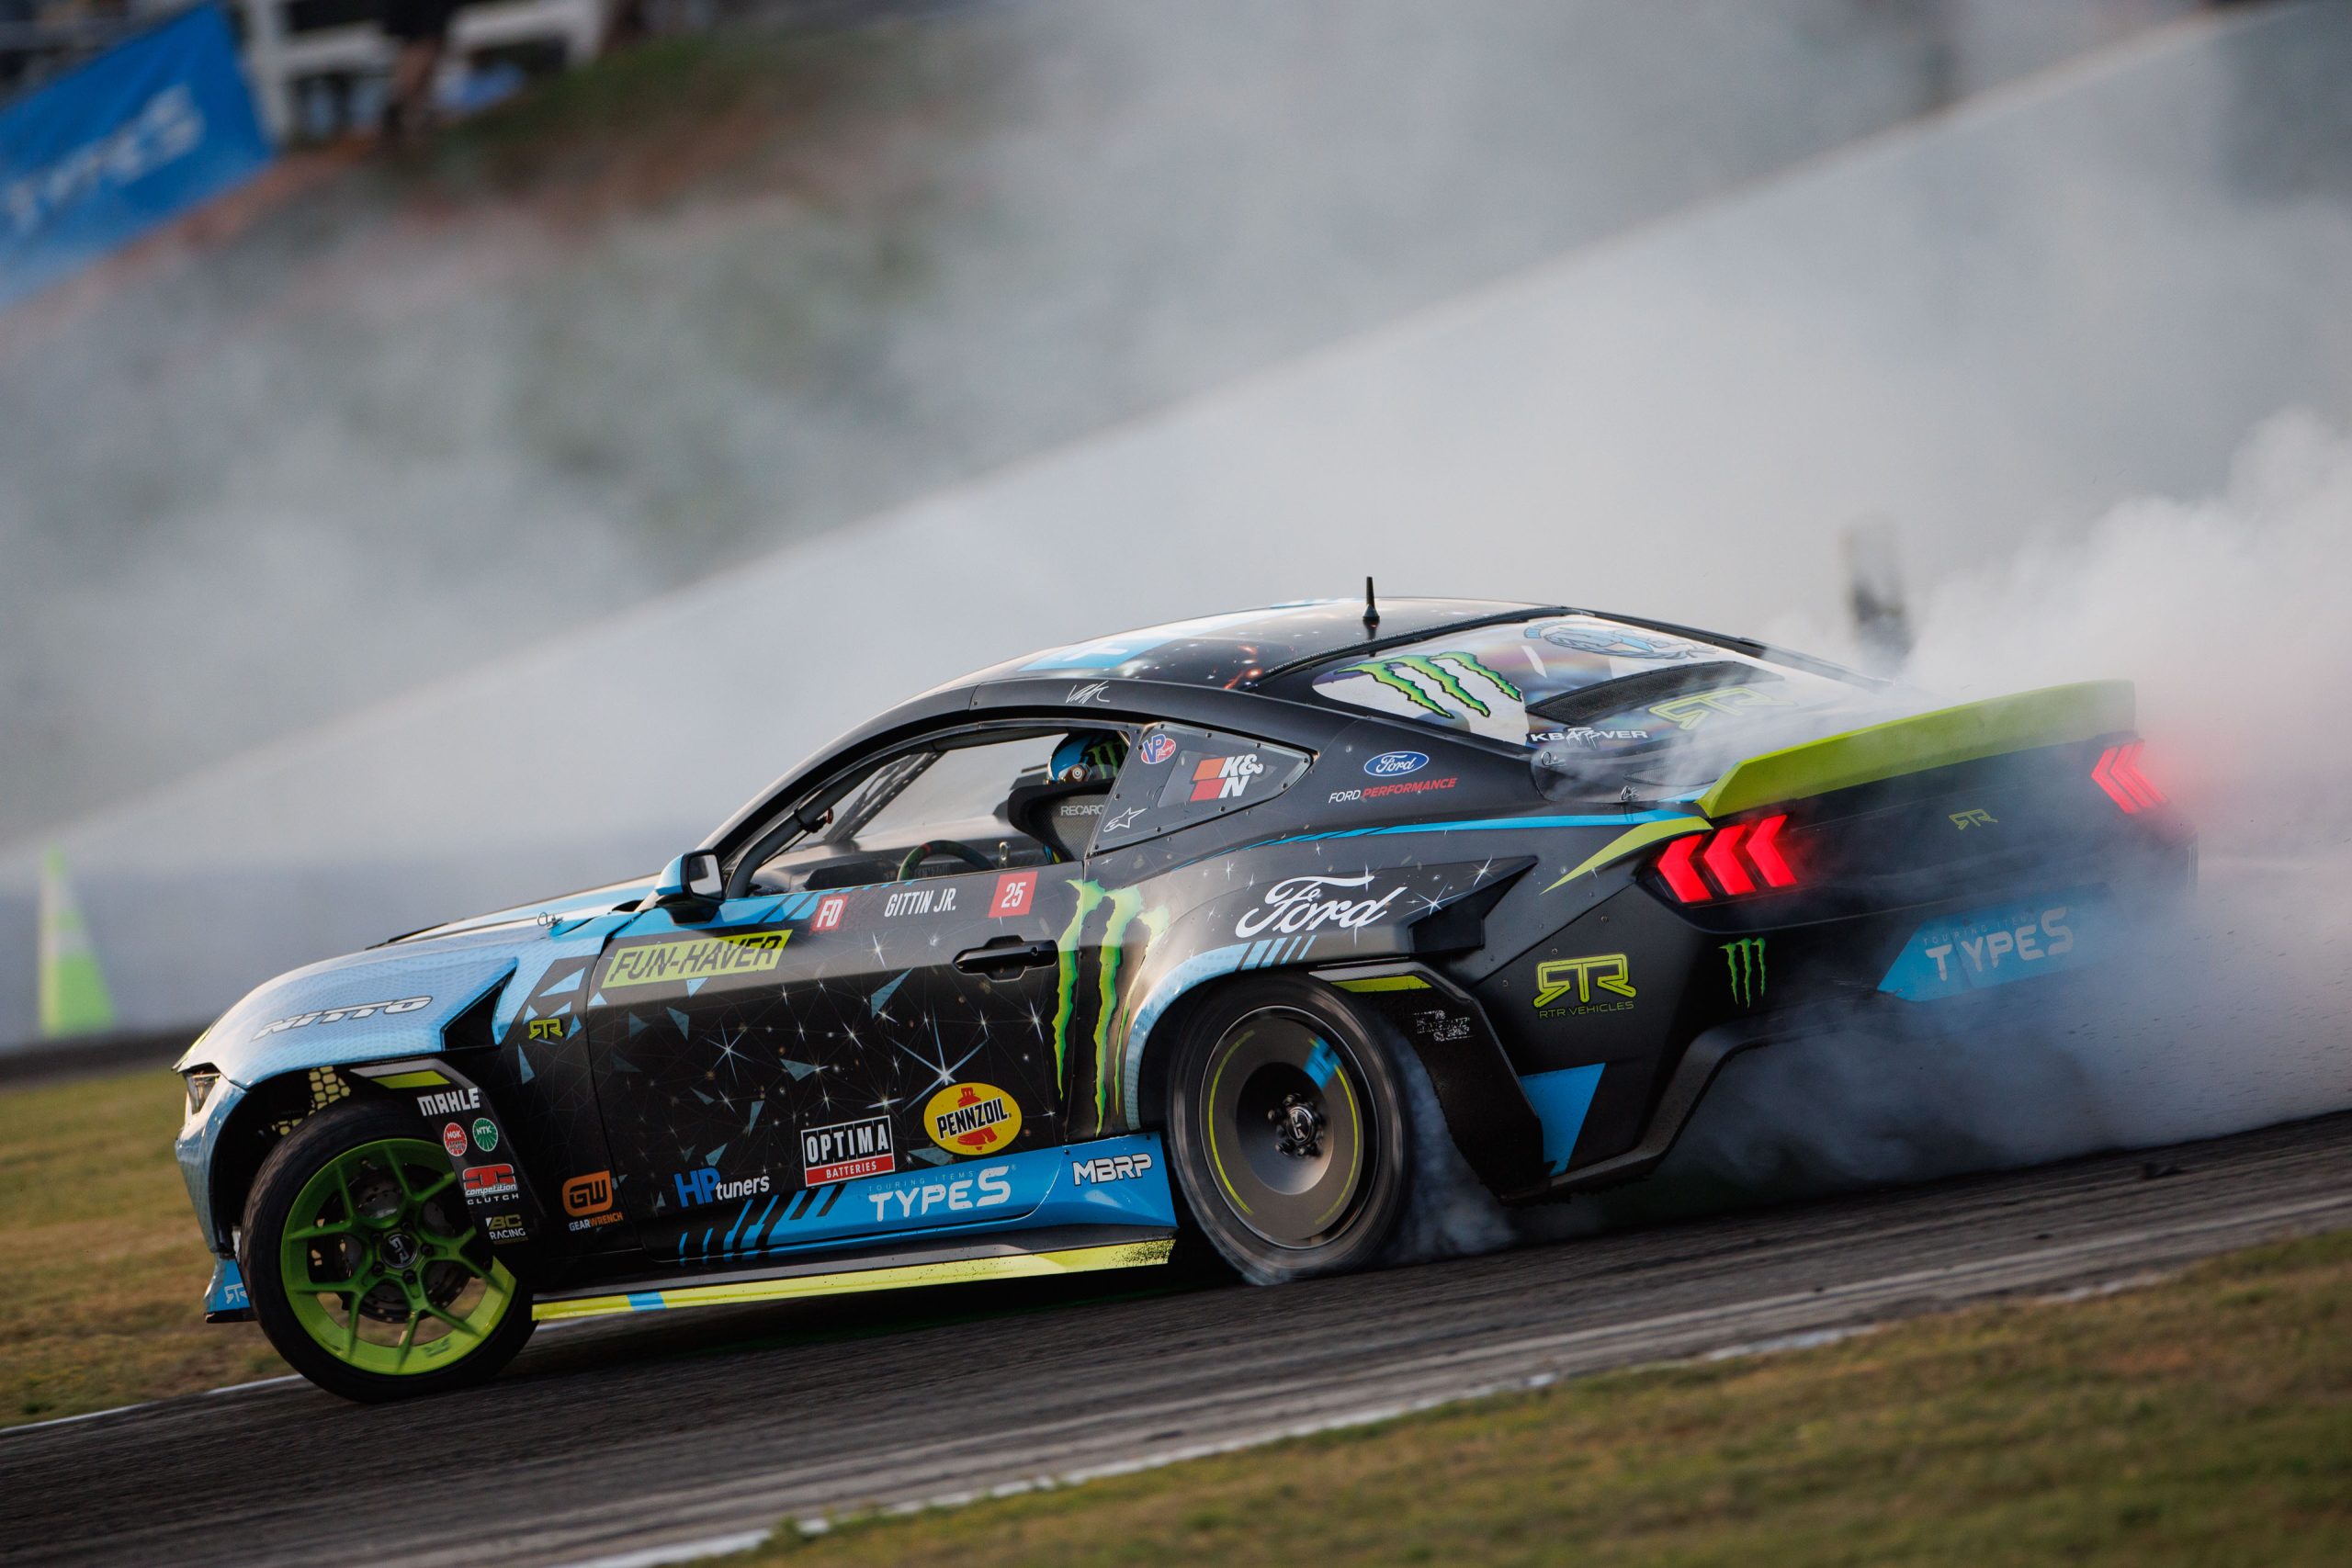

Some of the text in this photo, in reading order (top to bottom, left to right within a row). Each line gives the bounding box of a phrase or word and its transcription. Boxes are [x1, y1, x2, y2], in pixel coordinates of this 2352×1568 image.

[1142, 734, 1166, 764] VP
[1375, 754, 1417, 773] Ford
[1329, 778, 1458, 804] FORD PERFORMANCE
[884, 887, 956, 918] GITTIN JR.
[1001, 881, 1027, 908] 25
[1236, 875, 1408, 938] Ford
[817, 899, 843, 928] FD
[1925, 906, 2074, 982] TYPES
[609, 935, 783, 982] FUN-HAVER
[251, 996, 433, 1042] NITTO
[1539, 1001, 1634, 1019] RTR VEHICLES
[416, 1087, 481, 1117] MAHLE
[476, 1125, 492, 1135] NTK
[935, 1096, 1009, 1140] PENNZOIL
[807, 1123, 889, 1164] OPTIMA
[825, 1160, 877, 1179] BATTERIES
[869, 1170, 974, 1192] TOURING ITEMS
[1072, 1153, 1152, 1186] MBRP
[465, 1183, 517, 1198] competition
[467, 1192, 519, 1205] CLUTCH
[868, 1166, 1011, 1223] TYPES
[488, 1213, 523, 1230] BC
[489, 1227, 526, 1240] RACING
[569, 1213, 624, 1231] GEARWRENCH
